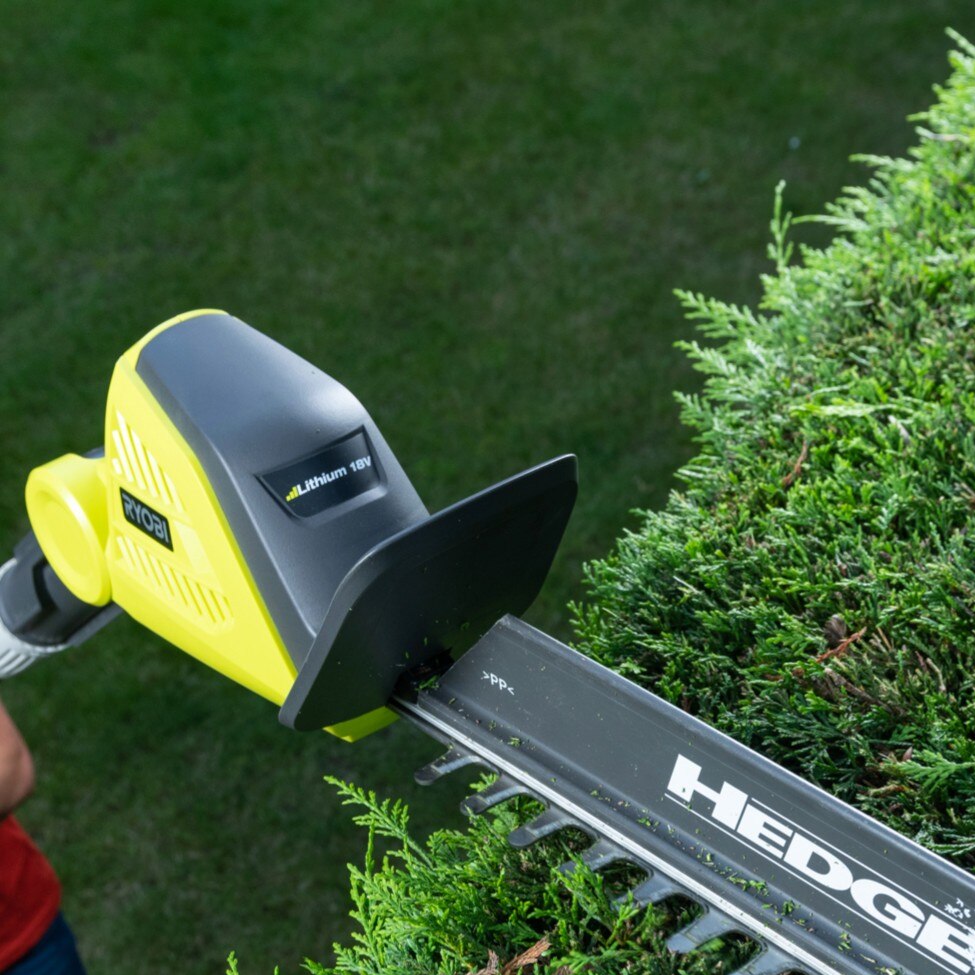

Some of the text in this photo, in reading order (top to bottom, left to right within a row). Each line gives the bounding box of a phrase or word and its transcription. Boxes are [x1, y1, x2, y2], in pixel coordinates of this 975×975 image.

[297, 456, 371, 495] Lithium 18V
[122, 493, 169, 543] RYOBI
[667, 753, 975, 974] HEDGE
